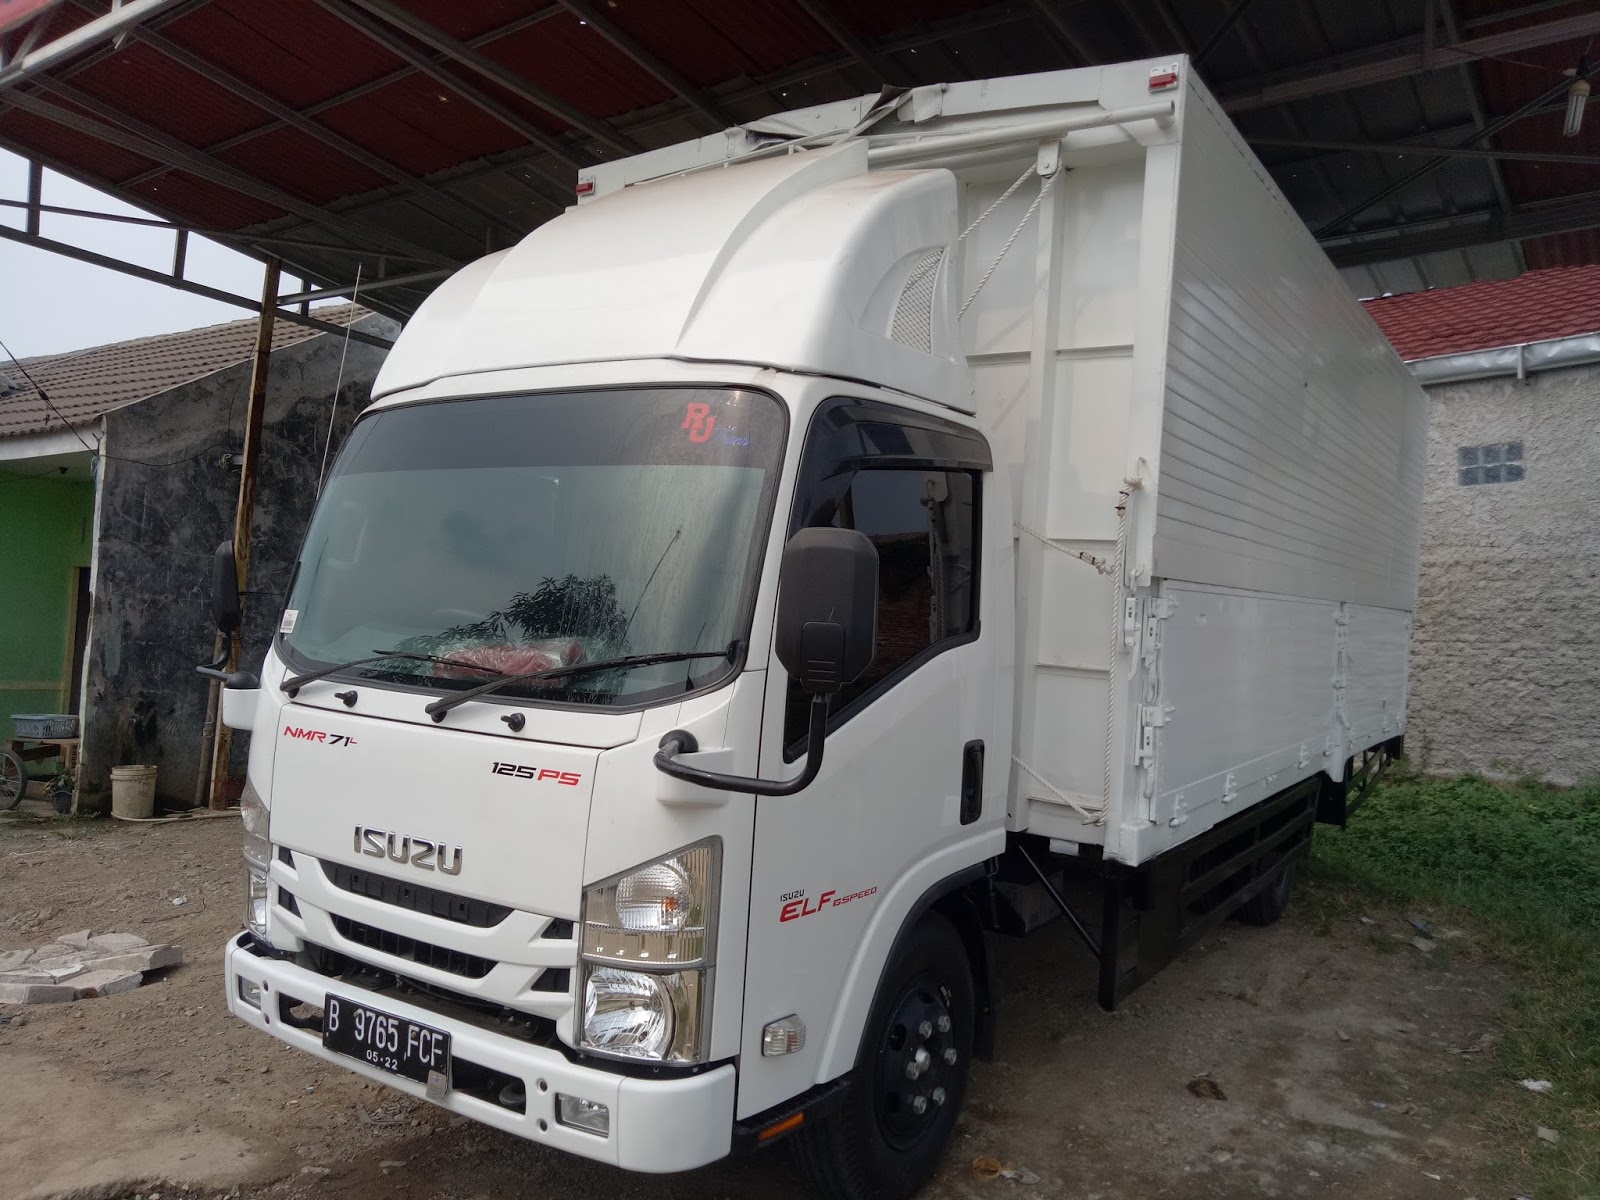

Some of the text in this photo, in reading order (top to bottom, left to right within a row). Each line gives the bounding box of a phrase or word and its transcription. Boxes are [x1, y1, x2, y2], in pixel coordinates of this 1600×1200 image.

[681, 402, 717, 443] RU
[283, 726, 327, 743] NMR
[491, 761, 582, 786] 125 PS
[353, 823, 463, 876] ISUZU
[779, 889, 836, 923] ELF
[780, 889, 805, 902] ISUZU
[328, 999, 443, 1067] B 9765 FCF
